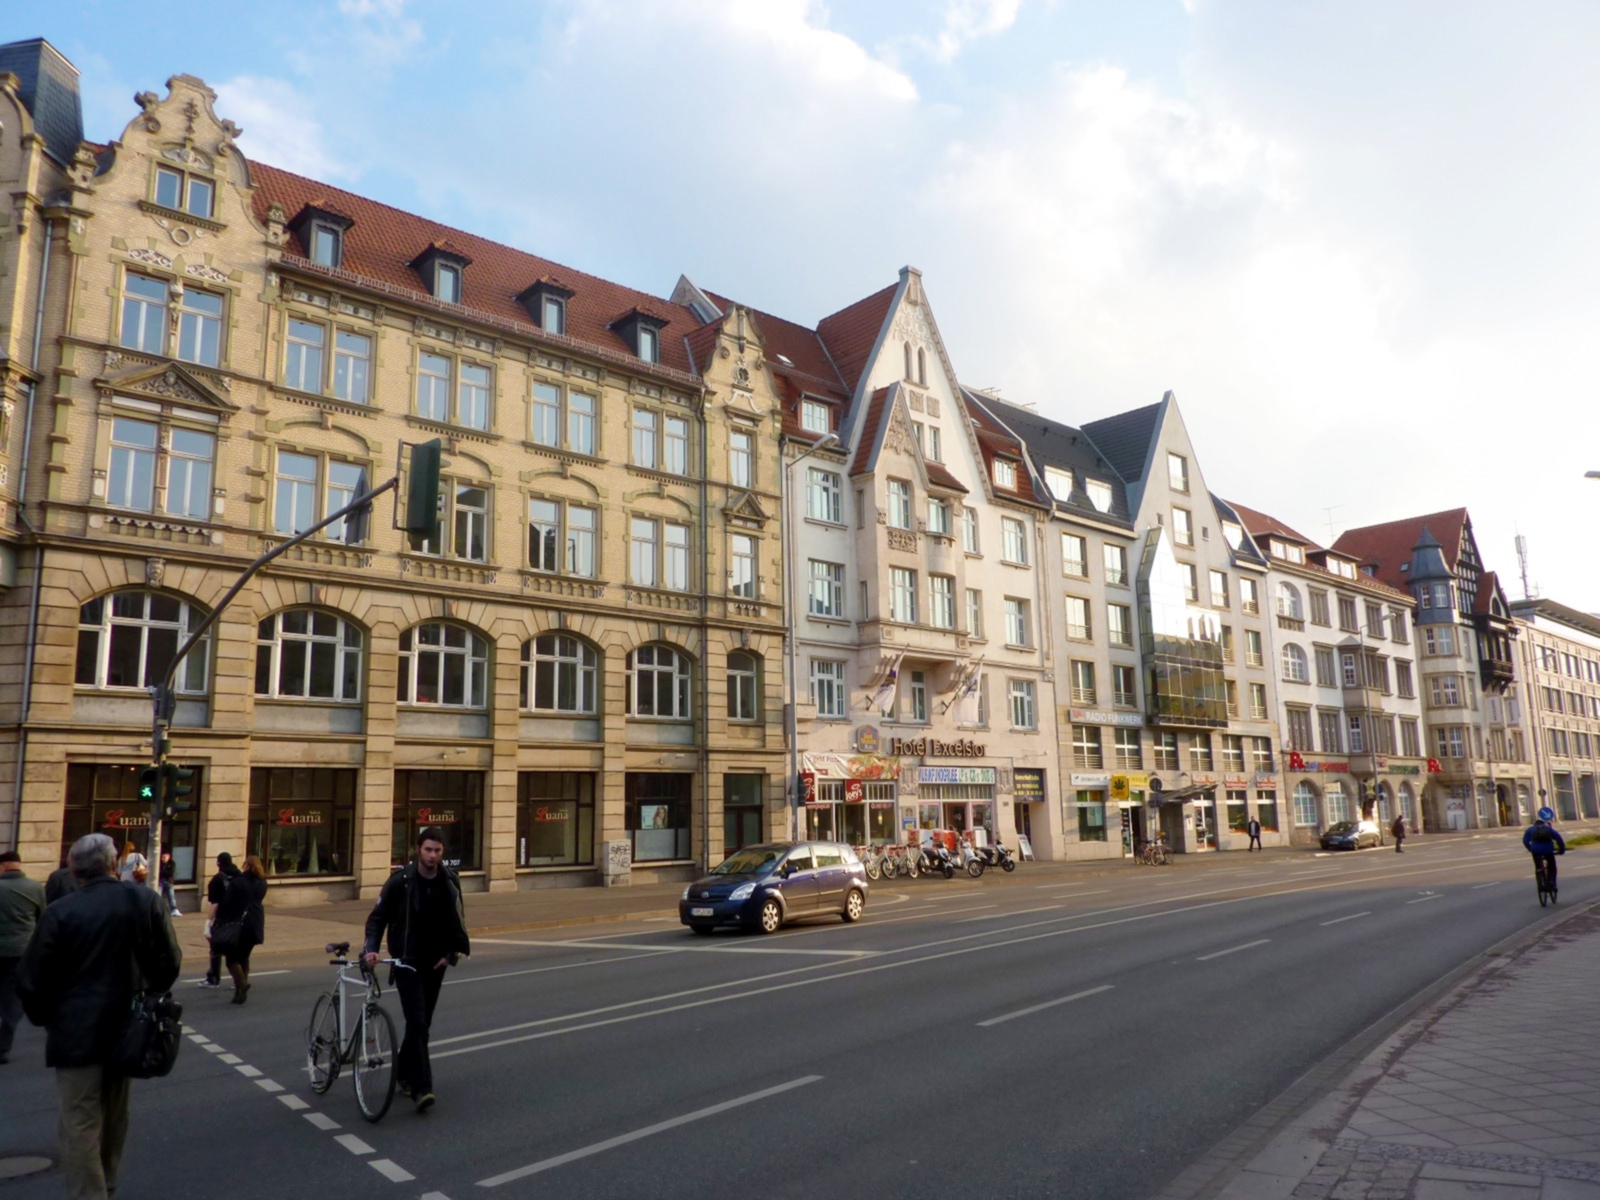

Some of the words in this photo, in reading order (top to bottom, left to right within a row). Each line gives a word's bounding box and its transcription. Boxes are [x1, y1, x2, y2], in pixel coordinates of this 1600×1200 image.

[1085, 712, 1107, 723] RADIO
[1108, 713, 1142, 725] FUNKWERK
[892, 737, 926, 756] Hotel
[931, 738, 987, 757] Excelsior
[276, 808, 324, 825] Luana
[416, 807, 457, 824] Luana
[535, 806, 569, 822] Luana
